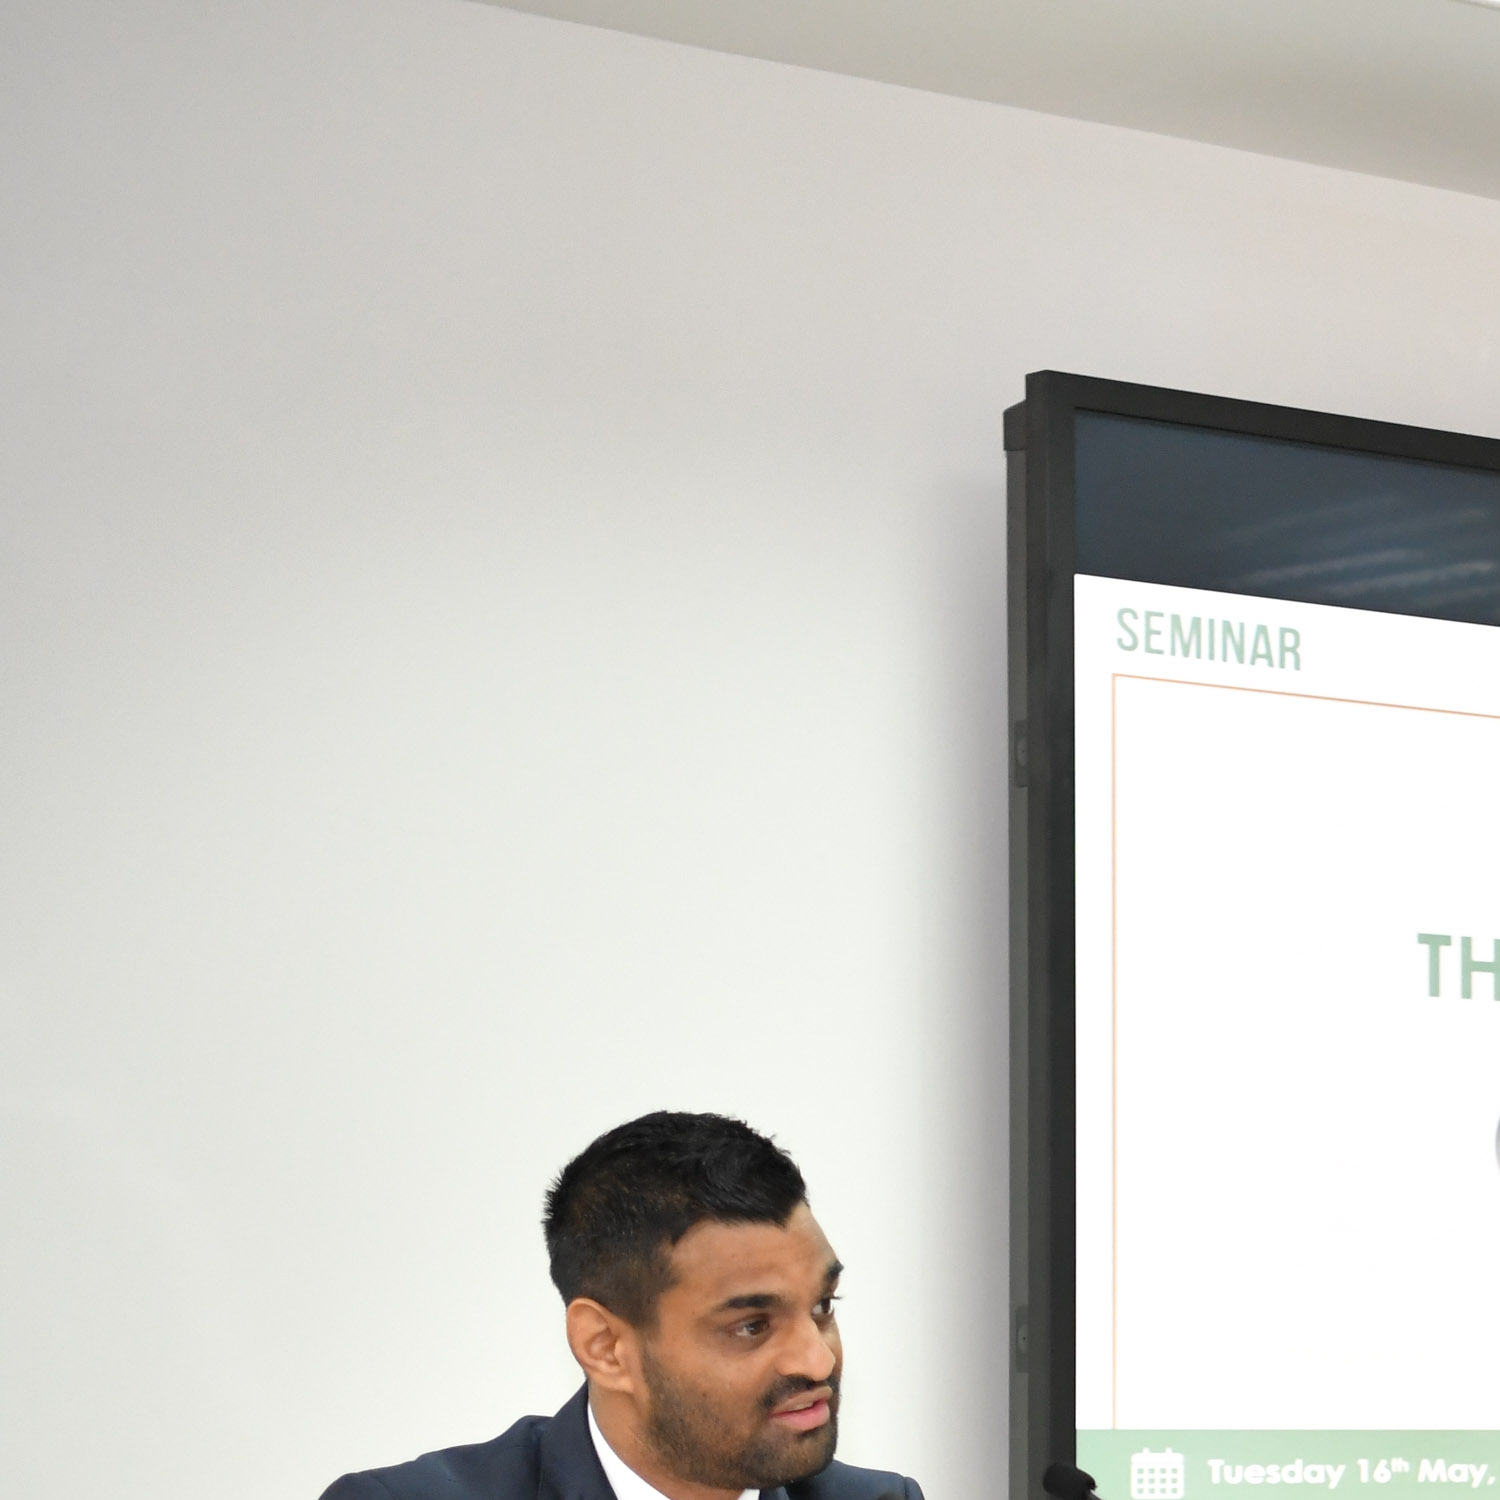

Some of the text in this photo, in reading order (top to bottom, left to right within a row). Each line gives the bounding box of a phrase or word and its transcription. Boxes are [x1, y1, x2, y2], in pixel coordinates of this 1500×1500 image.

[1116, 607, 1301, 671] SEMINAR
[1208, 1458, 1345, 1490] Tuesday
[1356, 1456, 1409, 1484] 16th
[1418, 1458, 1495, 1489] May,
